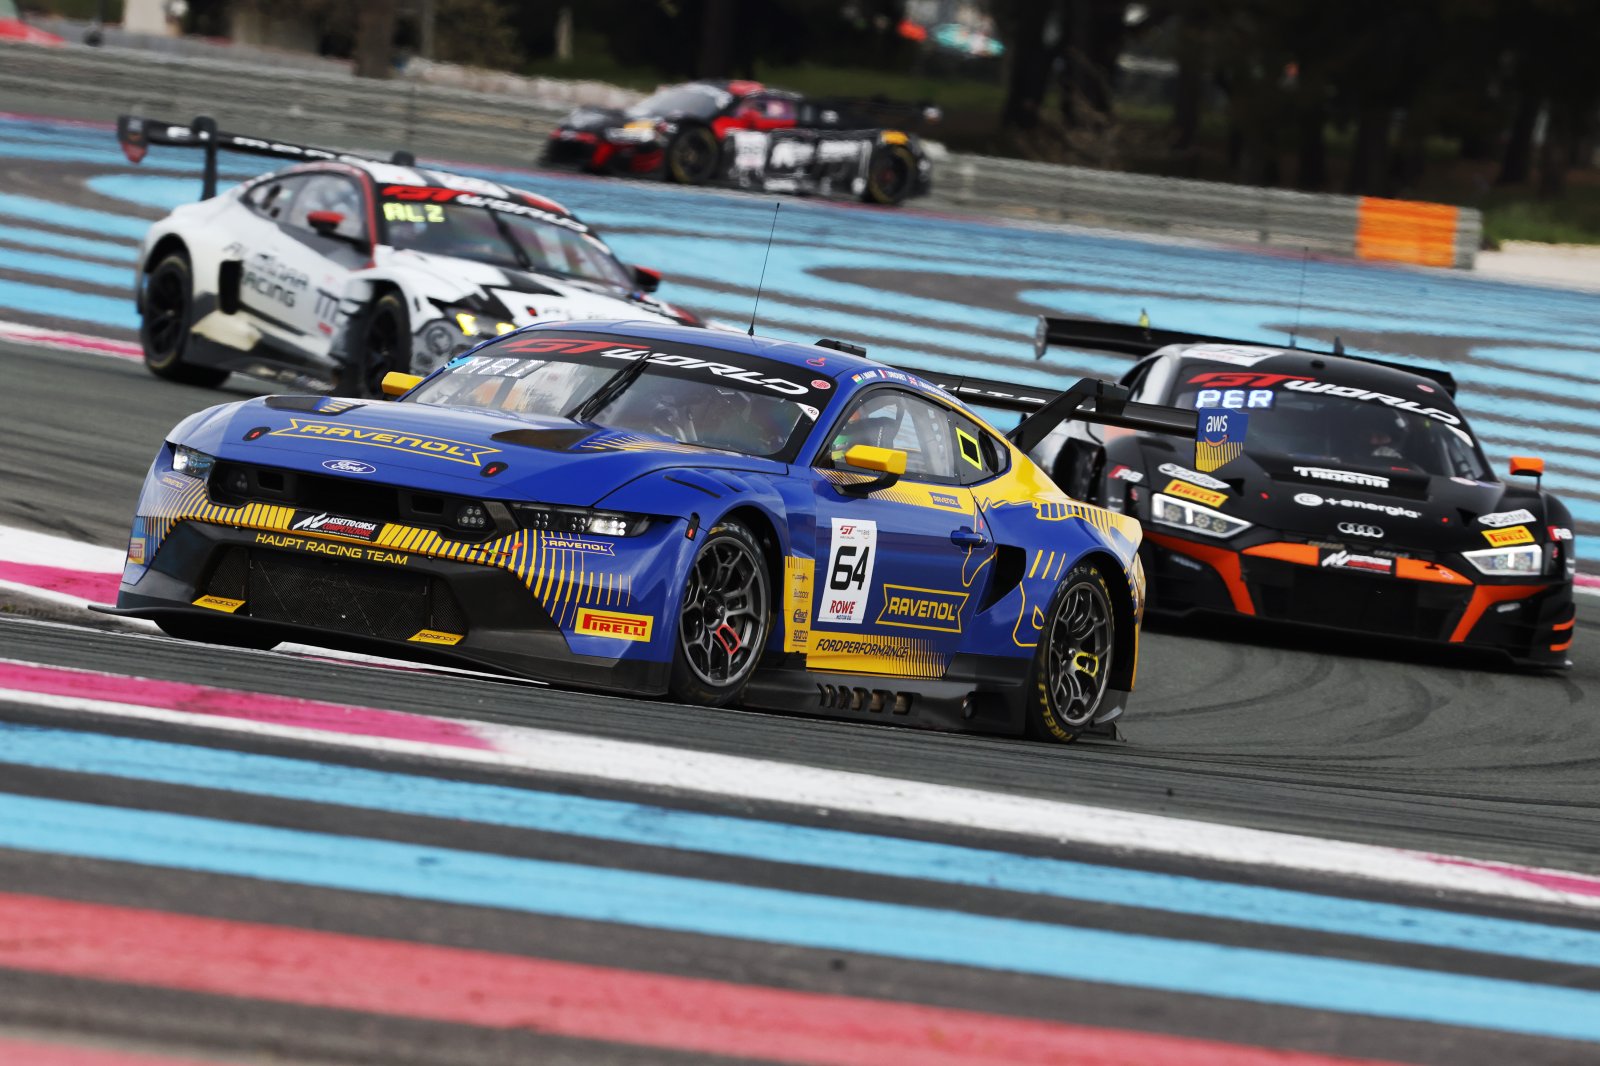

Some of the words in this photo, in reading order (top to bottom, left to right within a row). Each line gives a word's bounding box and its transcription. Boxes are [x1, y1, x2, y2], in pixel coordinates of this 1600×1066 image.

[501, 338, 653, 354] GT
[600, 348, 809, 396] WORLD
[1187, 372, 1316, 388] GT
[1283, 380, 1461, 425] WORLD
[1196, 389, 1274, 409] PER
[1205, 414, 1228, 433] aws
[299, 424, 466, 457] RAVENOL
[331, 461, 367, 474] Ford
[256, 533, 305, 552] HAUPT
[306, 541, 362, 560] RACING
[366, 550, 408, 565] TEAM
[549, 540, 608, 552] RAVENOL
[830, 545, 870, 591] 64
[829, 600, 856, 615] ROWE
[888, 597, 956, 621] RAVENOL
[582, 613, 647, 637] PIRELLI
